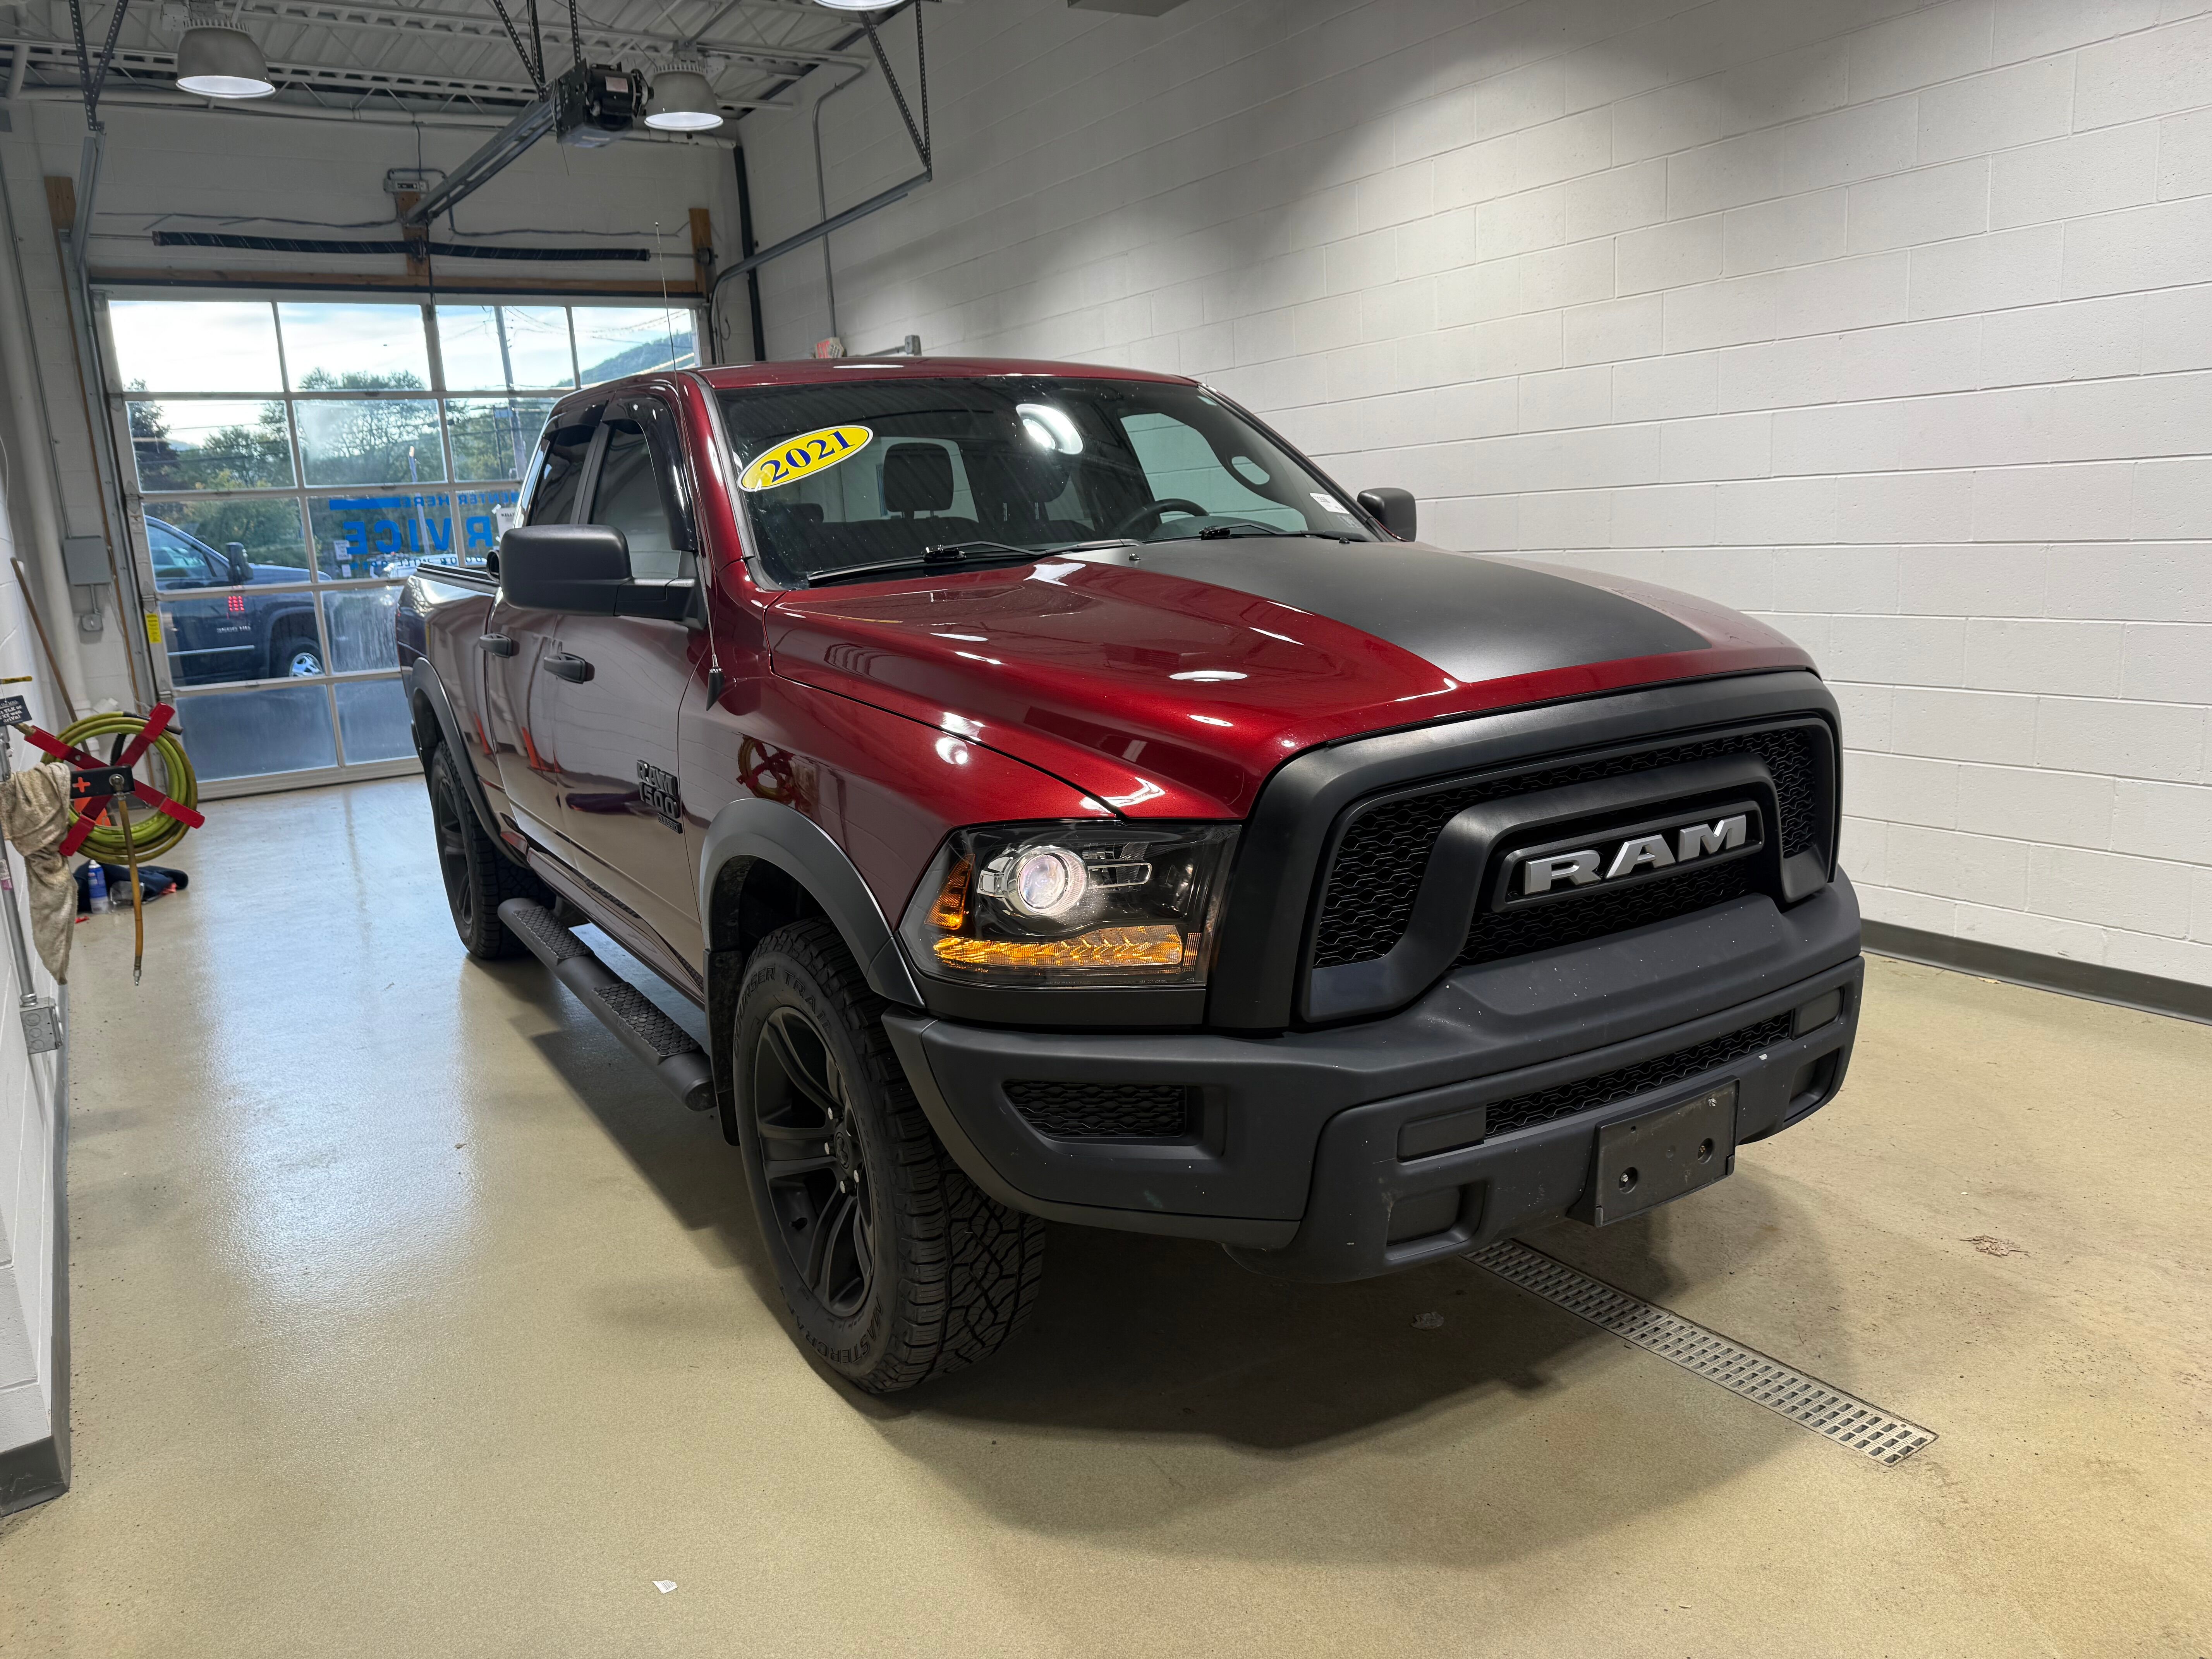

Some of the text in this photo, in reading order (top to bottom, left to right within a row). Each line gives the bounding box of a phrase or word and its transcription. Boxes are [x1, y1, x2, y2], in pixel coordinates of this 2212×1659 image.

[760, 430, 855, 483] 2021
[637, 759, 679, 796] RAM
[639, 782, 681, 819] 1500
[1523, 814, 1747, 895] RAM
[734, 966, 775, 1060] COURSER
[778, 1280, 884, 1364] MASTERCRAFT
